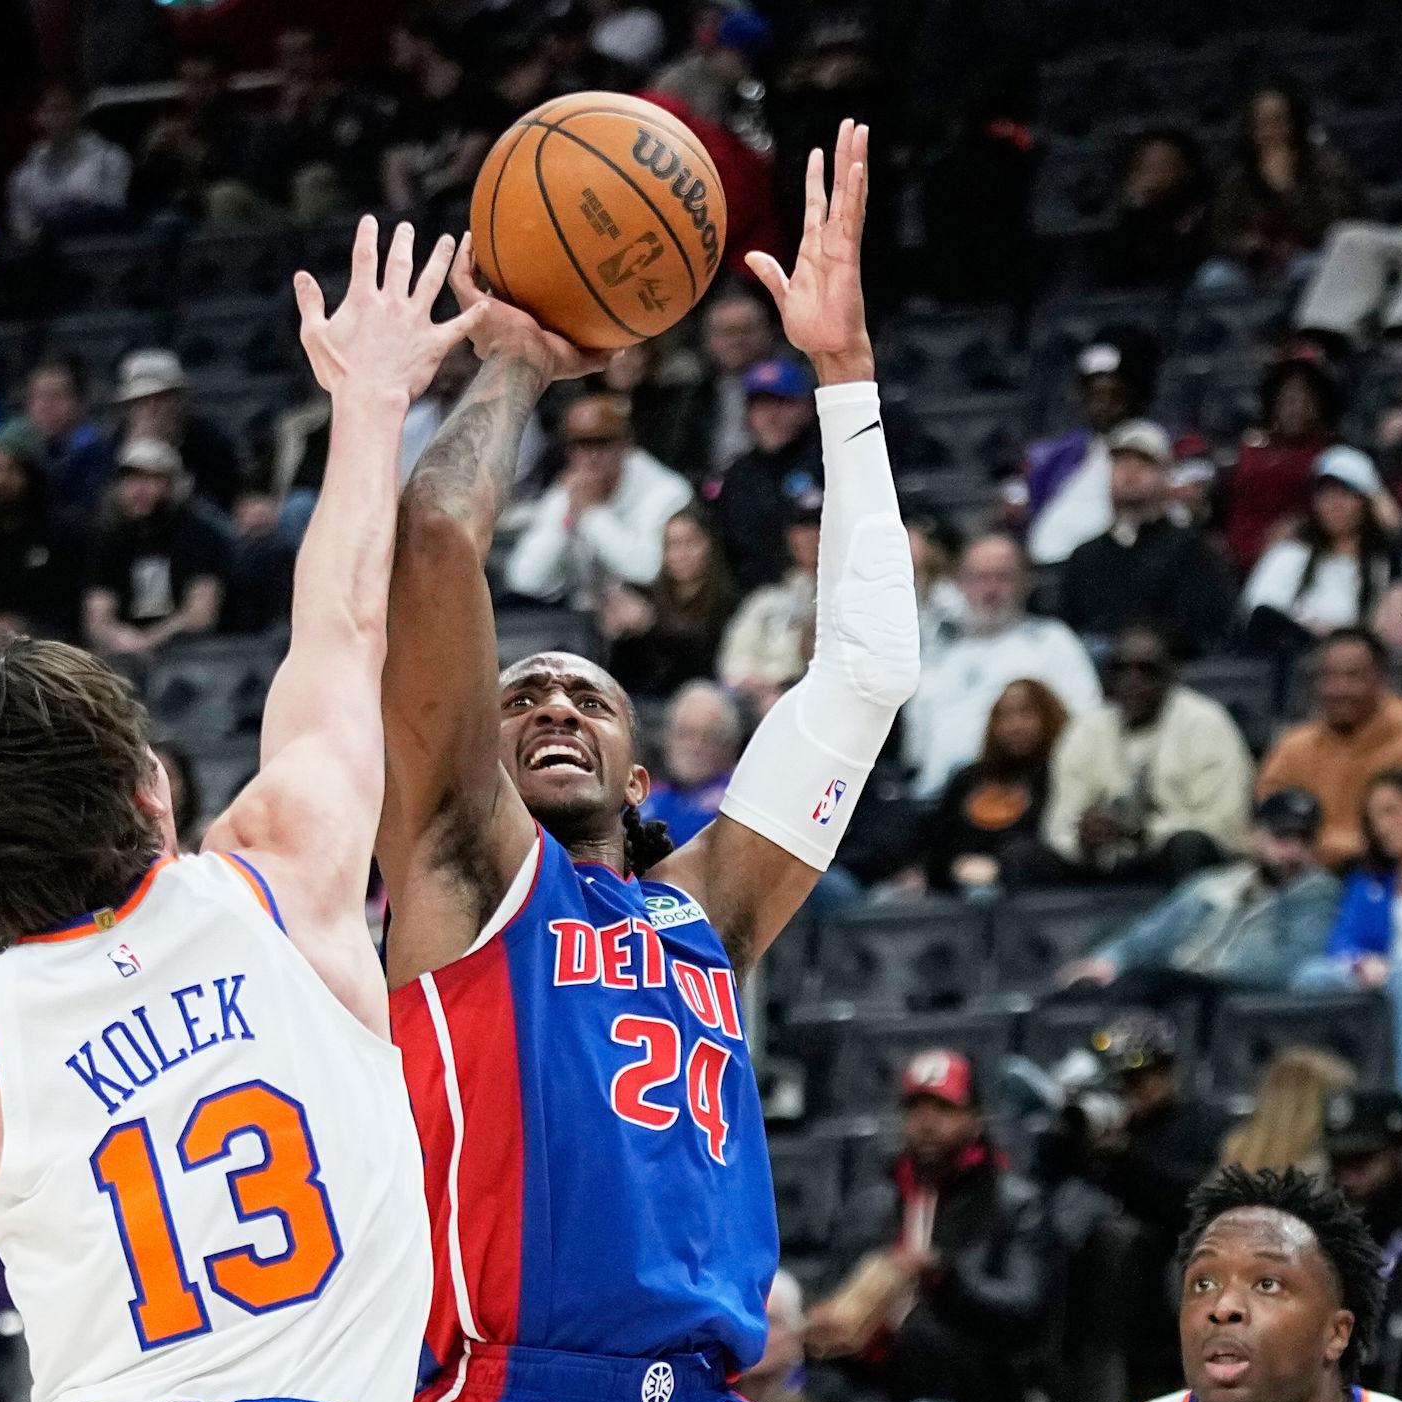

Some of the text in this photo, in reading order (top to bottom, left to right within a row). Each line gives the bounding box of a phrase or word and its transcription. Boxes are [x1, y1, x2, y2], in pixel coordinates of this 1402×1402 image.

[631, 126, 721, 277] Wilson
[65, 974, 256, 1115] KOLEK
[548, 916, 744, 1042] DETOI
[610, 1013, 732, 1166] 24
[90, 1079, 345, 1352] 13
